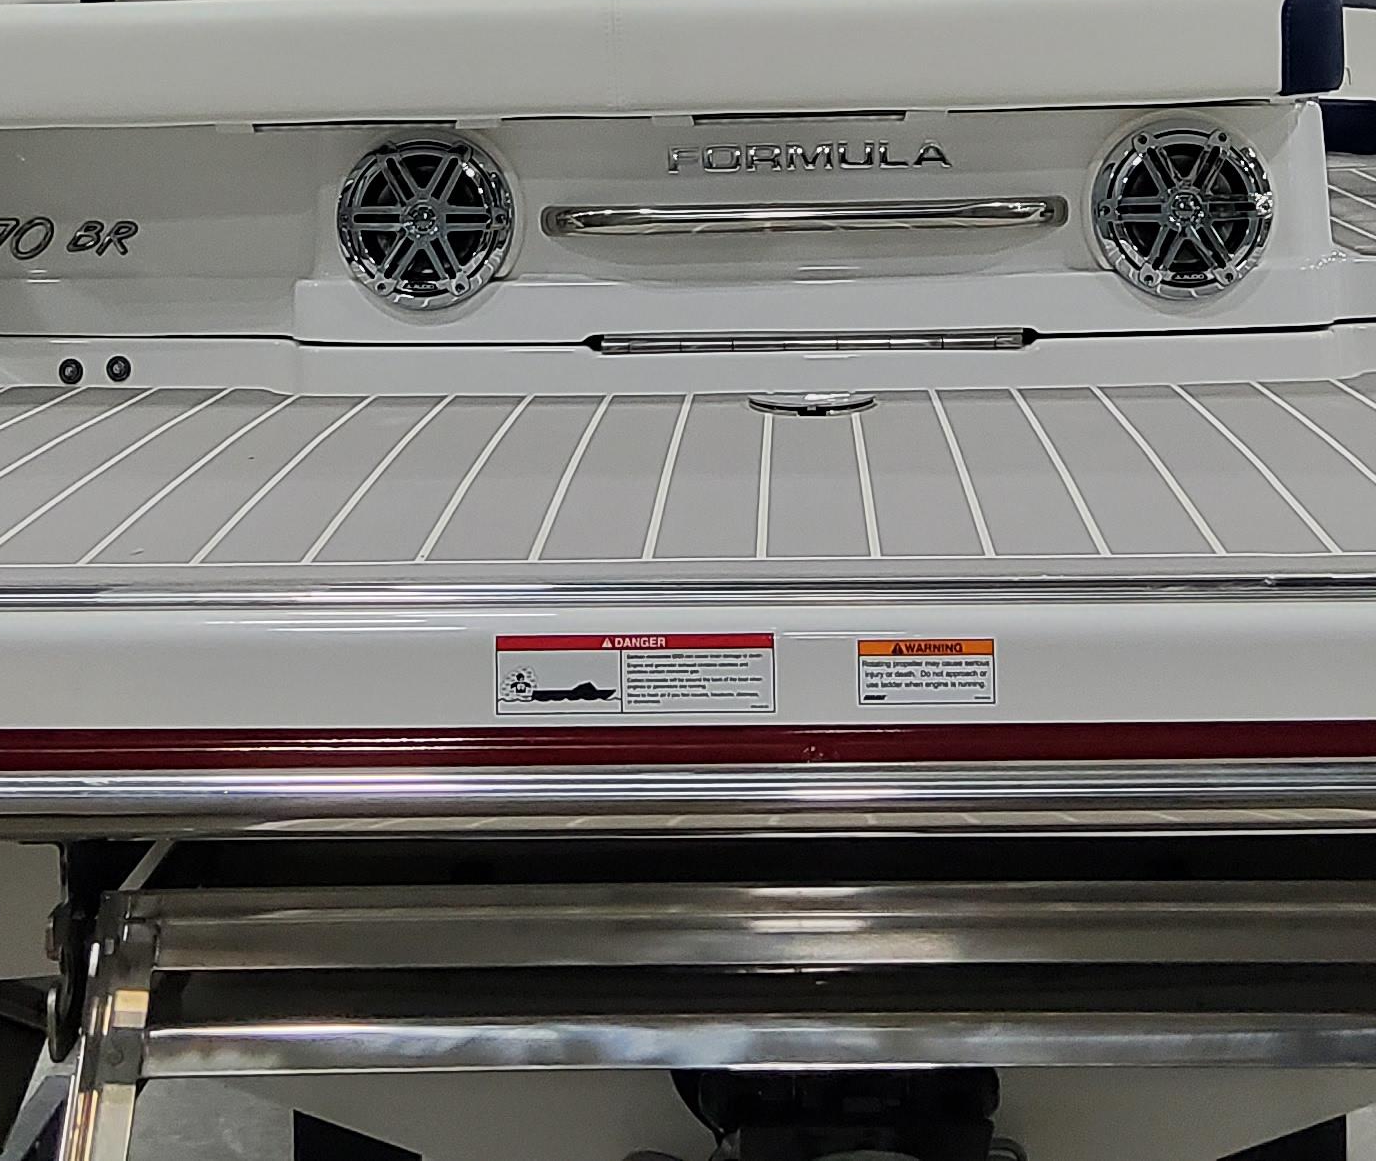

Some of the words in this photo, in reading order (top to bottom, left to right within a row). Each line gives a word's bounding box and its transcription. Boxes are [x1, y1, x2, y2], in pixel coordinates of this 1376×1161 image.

[667, 139, 953, 174] FORMULA
[66, 220, 139, 256] BR
[614, 637, 666, 648] DANGER
[904, 642, 963, 653] WARNING
